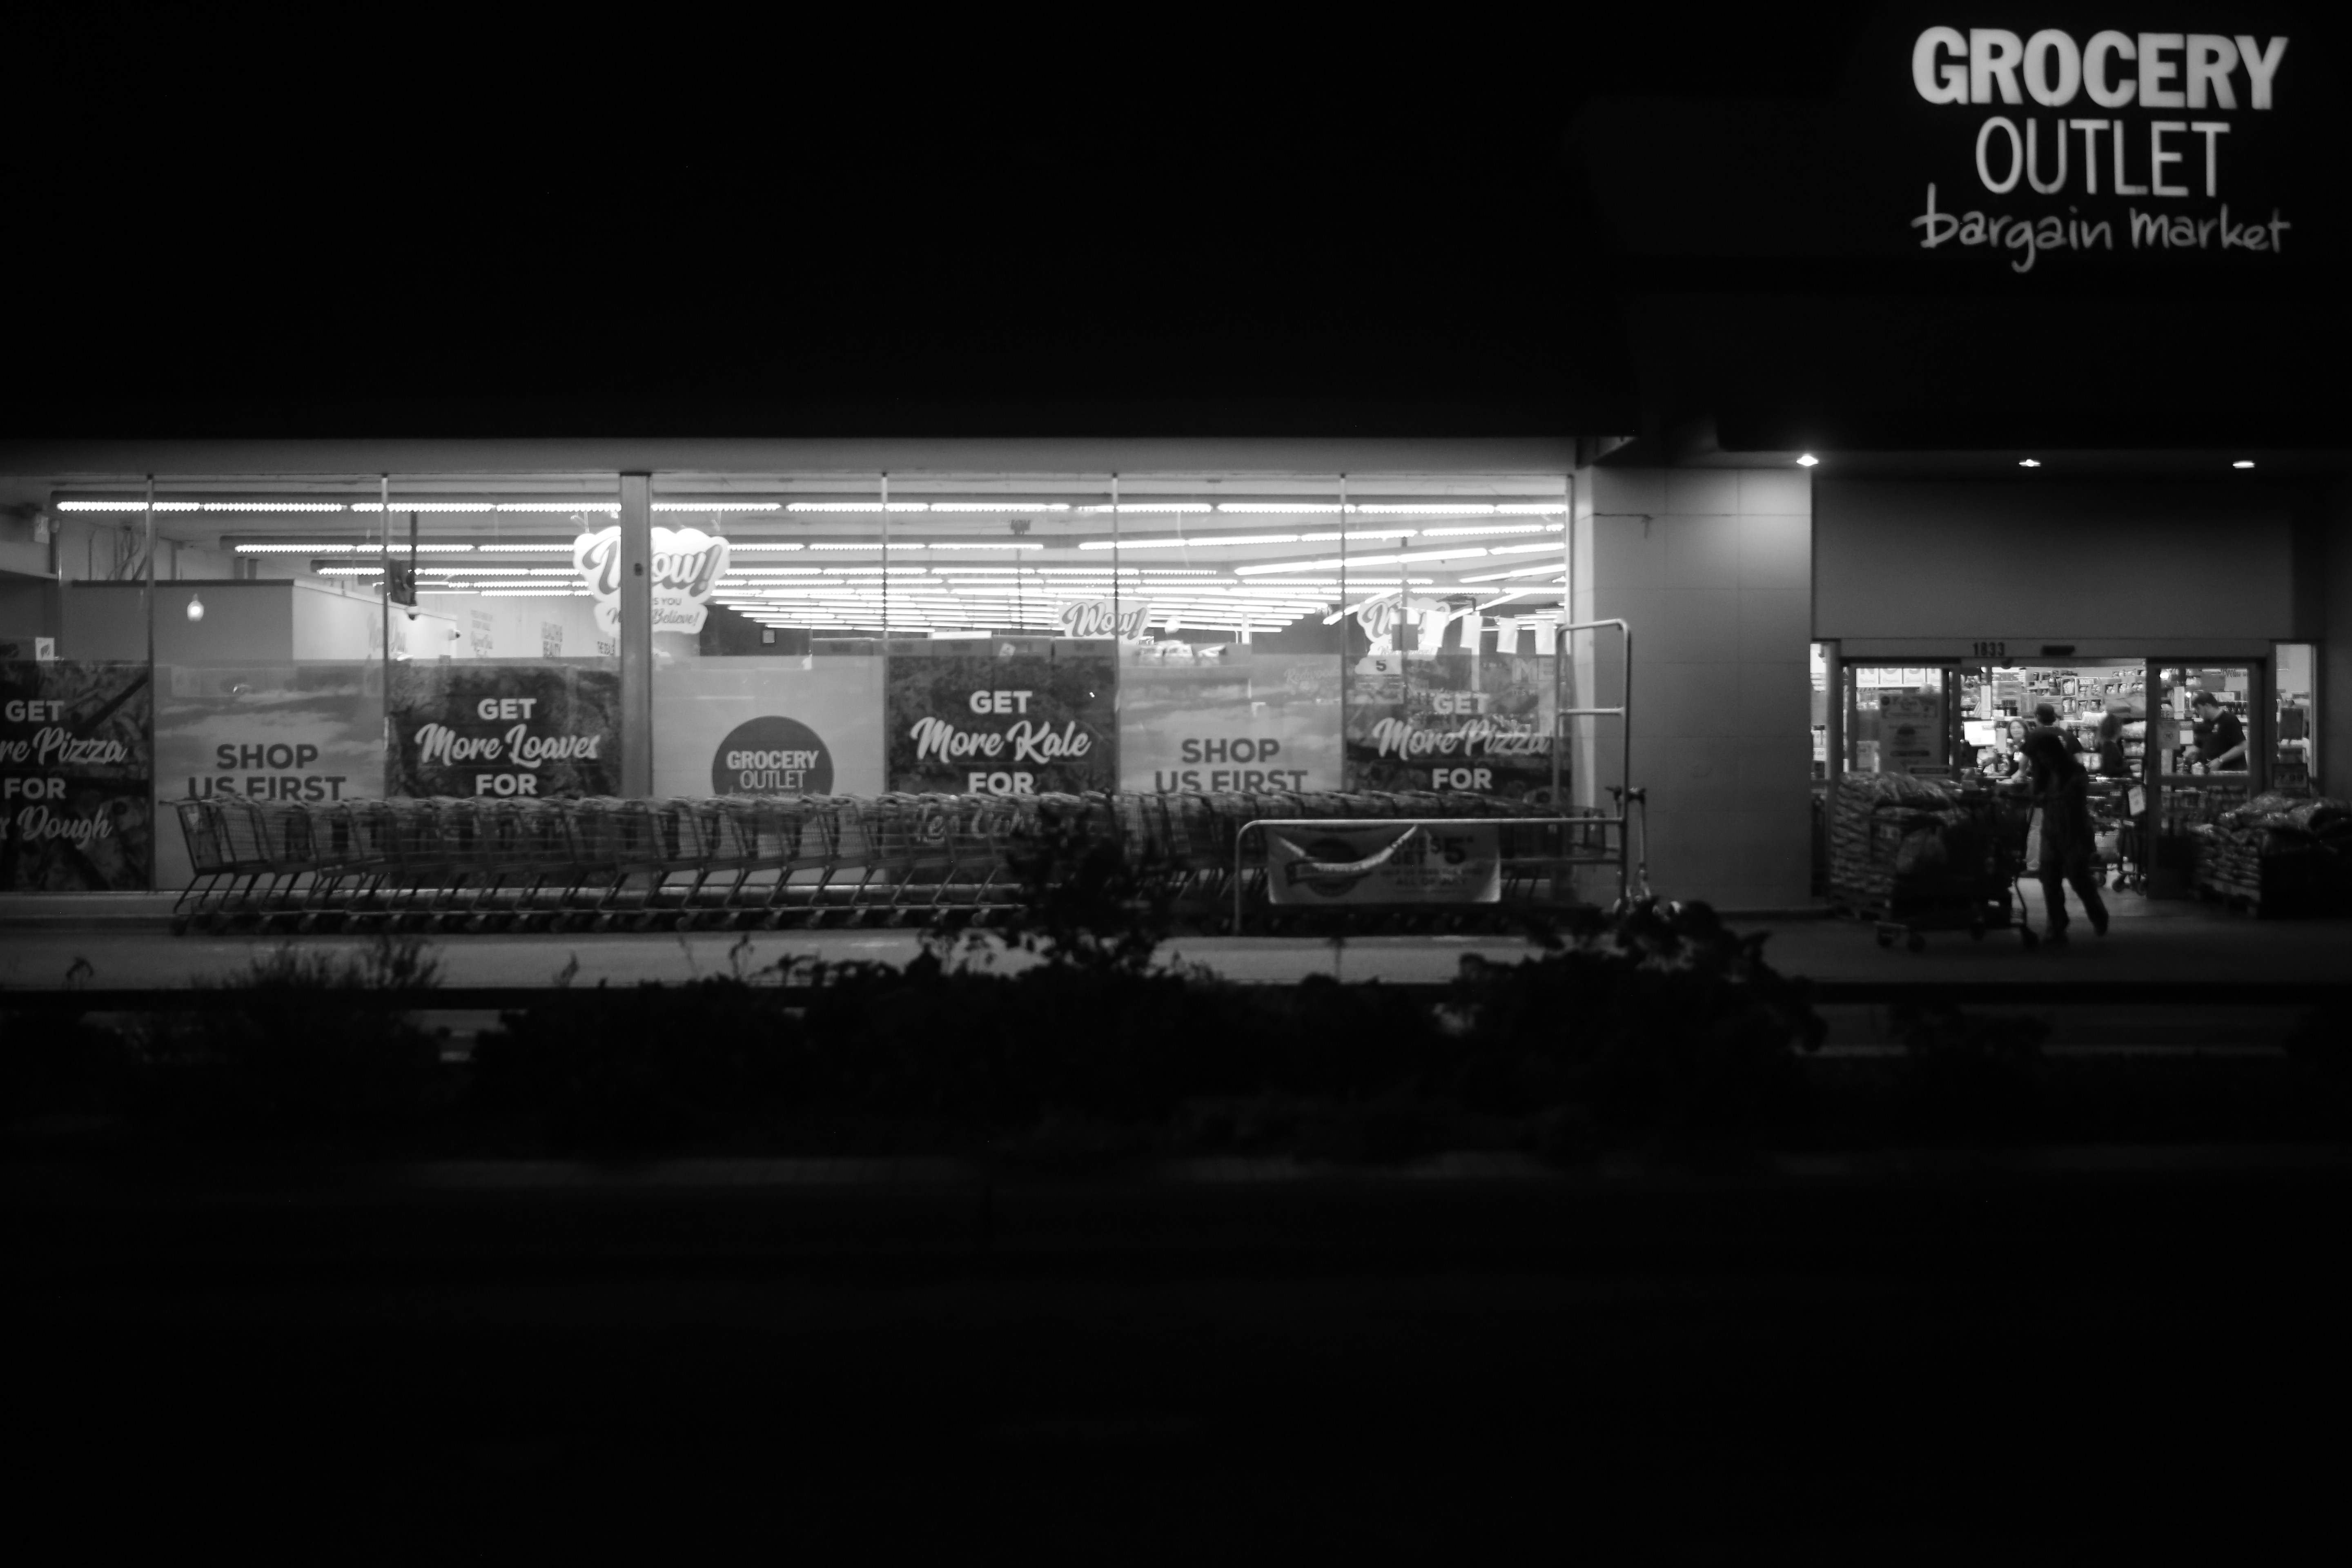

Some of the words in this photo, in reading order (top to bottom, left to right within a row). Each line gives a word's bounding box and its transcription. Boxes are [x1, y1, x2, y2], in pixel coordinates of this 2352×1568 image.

[1912, 25, 2290, 110] GROCERY
[1975, 116, 2231, 198] OUTLET
[1910, 182, 2114, 273] bargain
[2130, 203, 2292, 253] market
[662, 597, 682, 606] YOU
[1973, 641, 2005, 656] 1833
[5, 700, 64, 722] GET
[477, 698, 537, 720] GET
[969, 690, 1033, 714] GET
[1432, 693, 1490, 714] GET
[0, 740, 31, 762] re
[32, 727, 128, 766] Pizza
[414, 723, 503, 767] More
[504, 724, 602, 768] Loaves
[910, 716, 1004, 764] More
[1006, 720, 1092, 764] Kale
[1372, 717, 1459, 761] More
[1457, 719, 1552, 756] Pizza
[217, 744, 318, 769] SHOP
[726, 750, 819, 769] GROCERY
[1182, 738, 1280, 764] SHOP
[4, 777, 67, 800] FOR
[189, 776, 236, 800] US
[247, 776, 347, 801] FIRST
[475, 773, 538, 795] FOR
[739, 770, 806, 789] OUTLET
[968, 772, 1035, 795] FOR
[1155, 770, 1202, 793] US
[1211, 770, 1308, 793] FIRST
[1432, 768, 1493, 789] FOR
[16, 805, 114, 850] Dough
